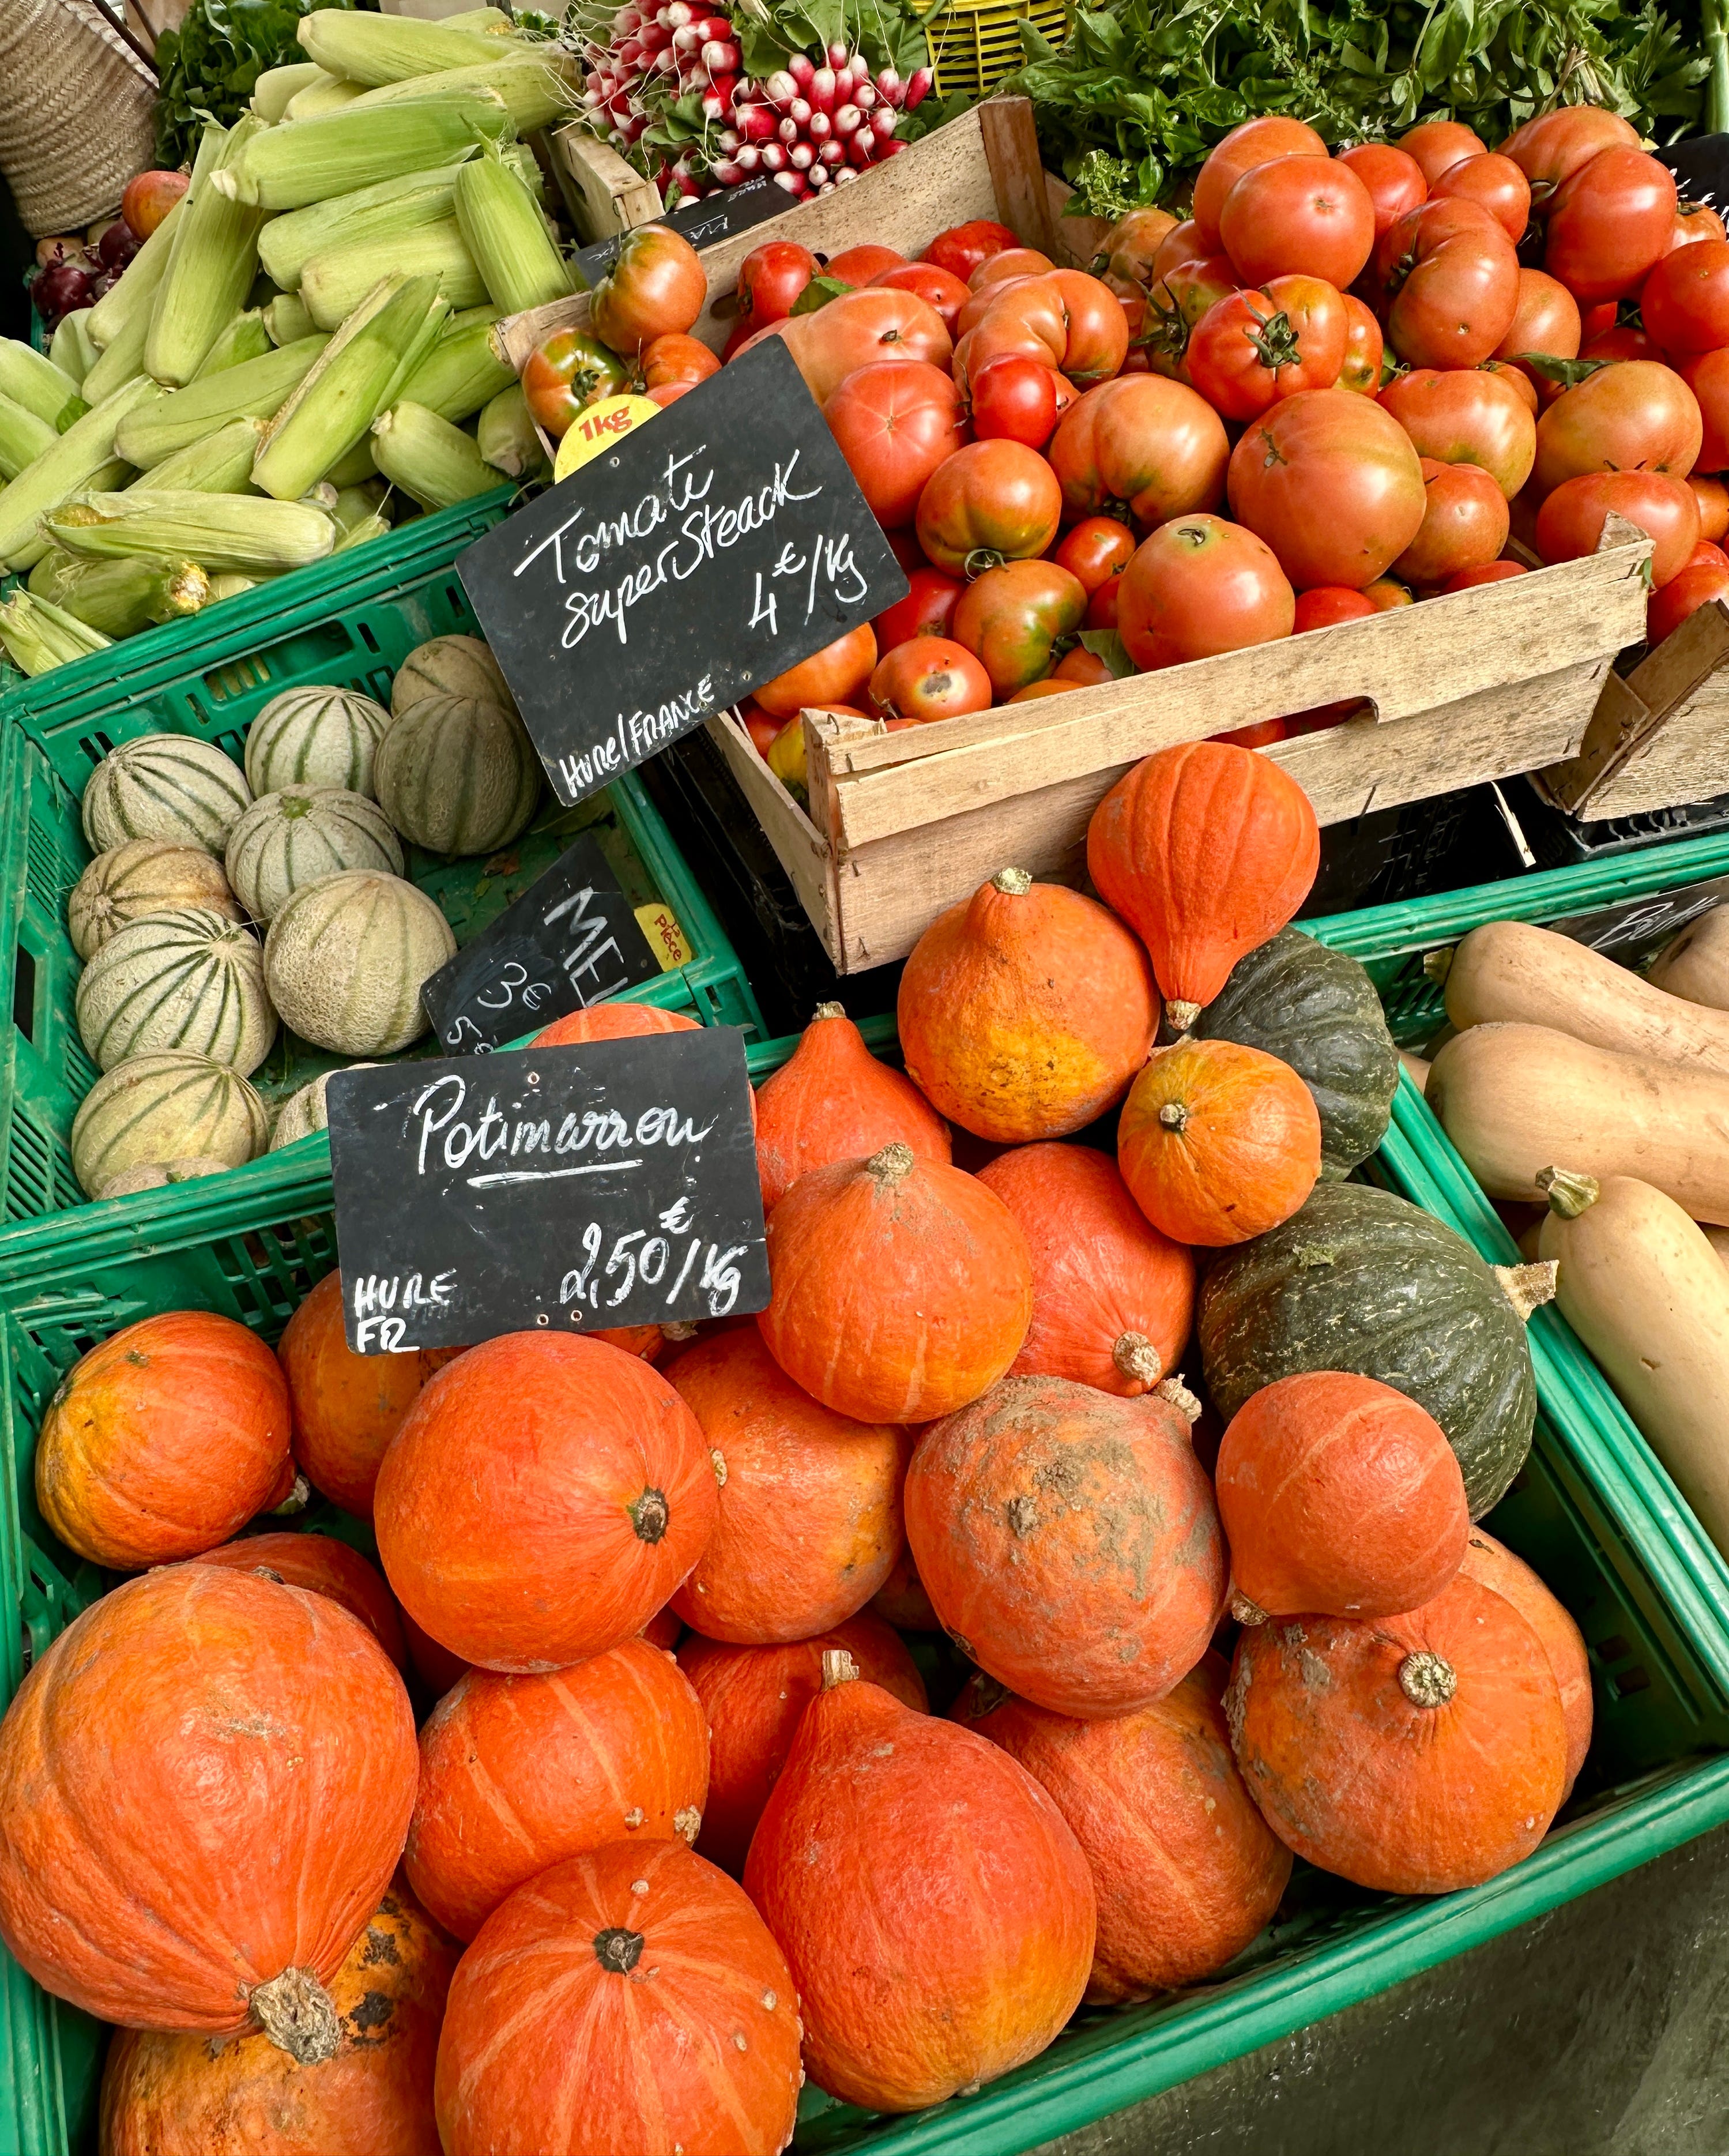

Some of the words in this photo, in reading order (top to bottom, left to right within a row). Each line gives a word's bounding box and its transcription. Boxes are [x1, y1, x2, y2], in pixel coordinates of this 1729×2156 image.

[578, 405, 632, 442] 1kg
[513, 444, 713, 584] Tomate
[413, 1074, 720, 1175] Potimarron
[353, 1267, 458, 1318] HURE
[356, 1315, 420, 1353] FR
